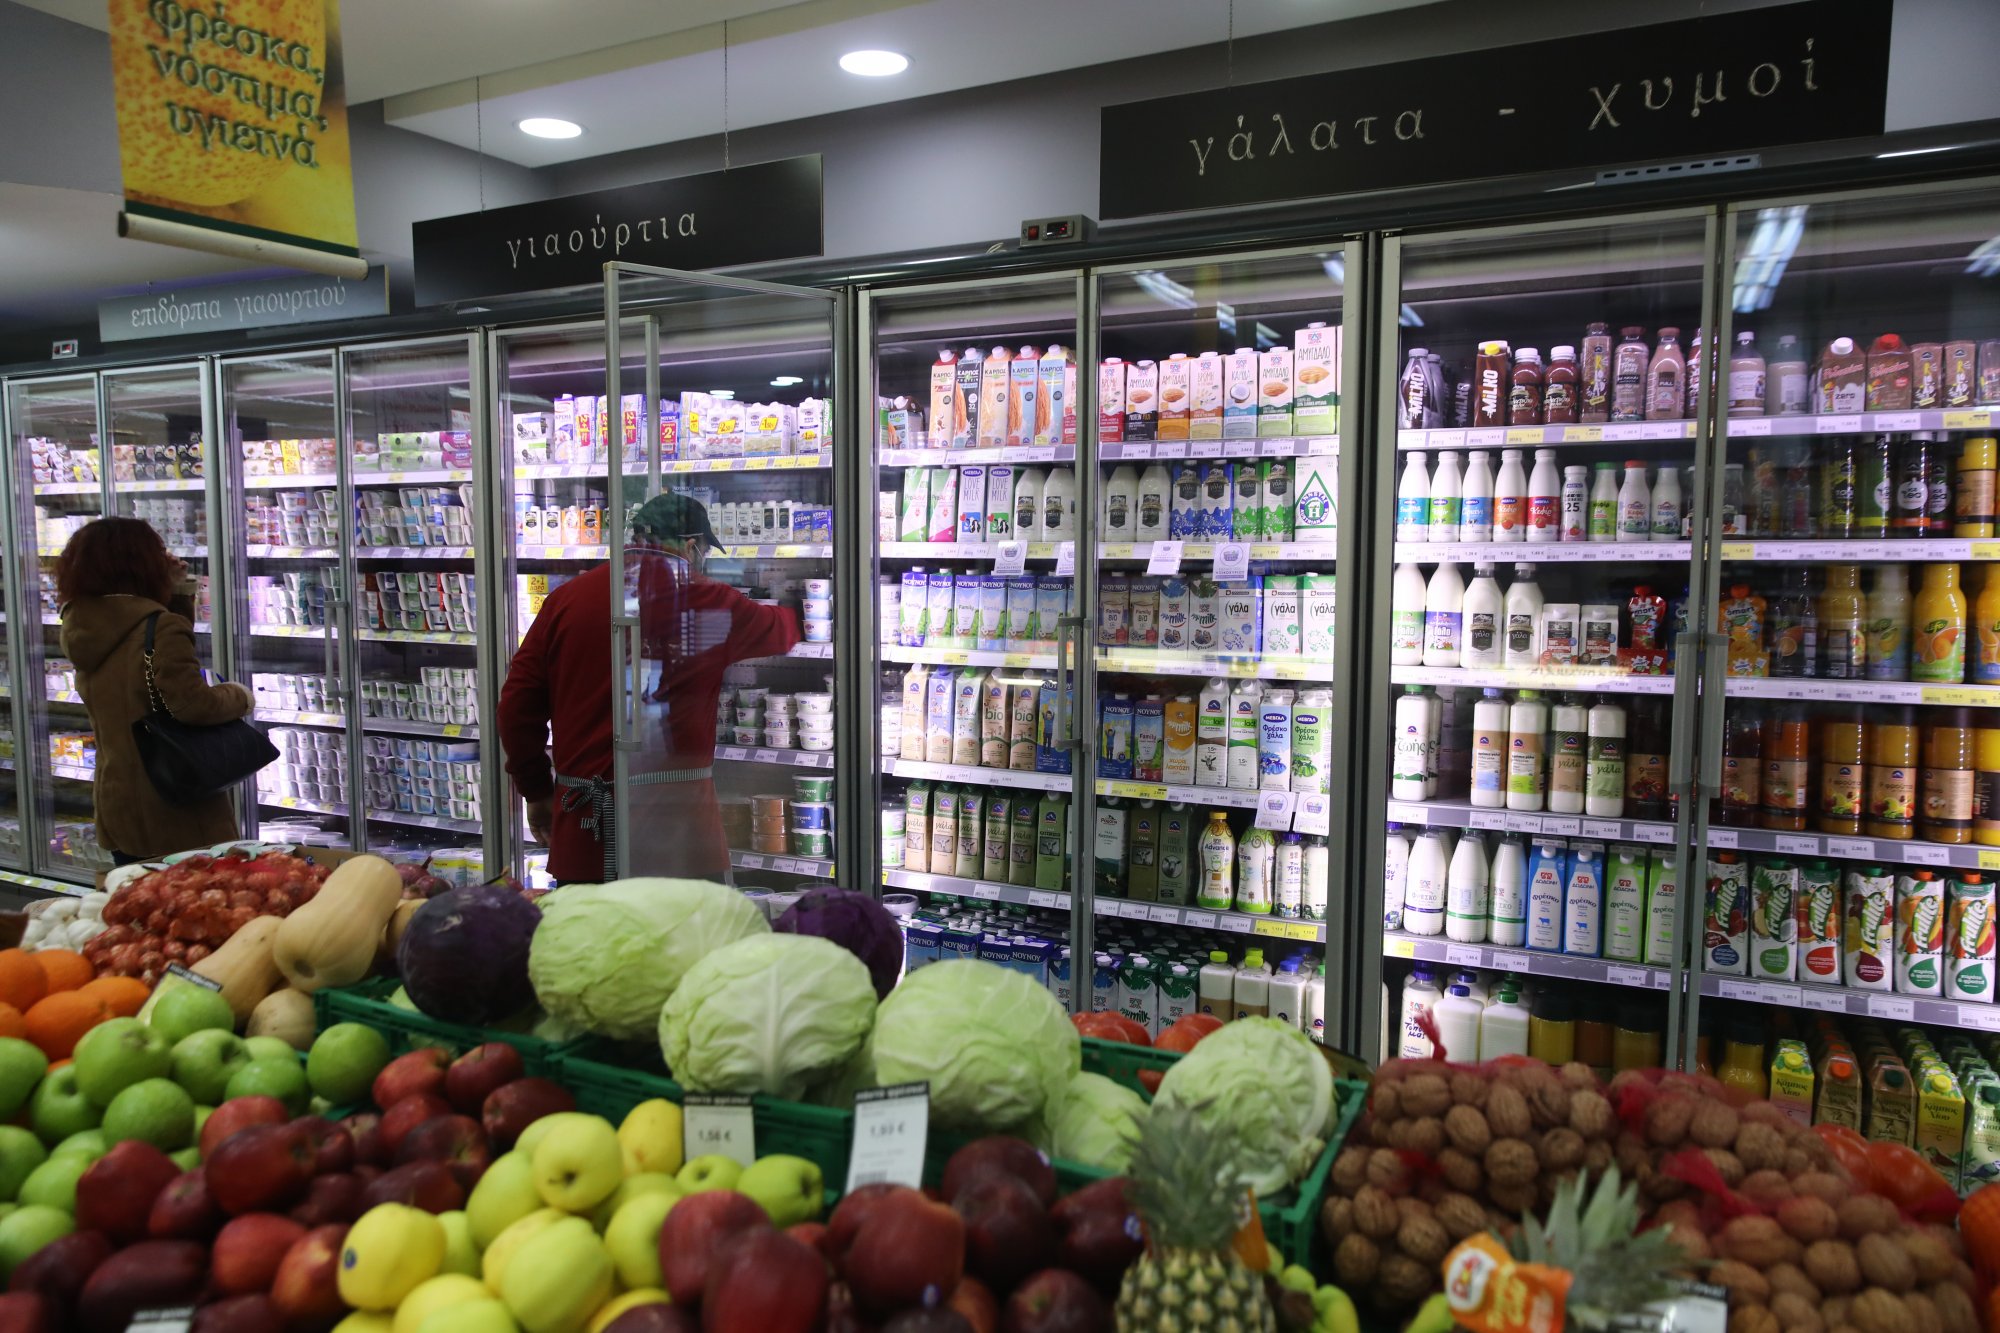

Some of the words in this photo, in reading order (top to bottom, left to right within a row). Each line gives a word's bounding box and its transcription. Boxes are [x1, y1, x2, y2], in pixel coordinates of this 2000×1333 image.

[1189, 108, 1424, 175] γάλατα
[1589, 38, 1818, 130] χυμοί
[165, 101, 320, 169] υγιεινά
[506, 211, 697, 268] γιαούρτια
[131, 294, 222, 329] επιδόρπια
[234, 276, 346, 317] γιαουρτιού
[964, 478, 980, 489] LOVE
[991, 478, 1007, 489] LOVE
[964, 490, 980, 501] MILK
[991, 490, 1007, 501] MILK
[985, 707, 1003, 721] bio
[1015, 708, 1034, 722] bio
[1263, 724, 1287, 732] Φρέσκο
[1295, 725, 1318, 734] Φρέσκο
[1266, 731, 1283, 739] γάλα
[1298, 733, 1314, 741] γάλα
[1597, 764, 1621, 774] γάλα
